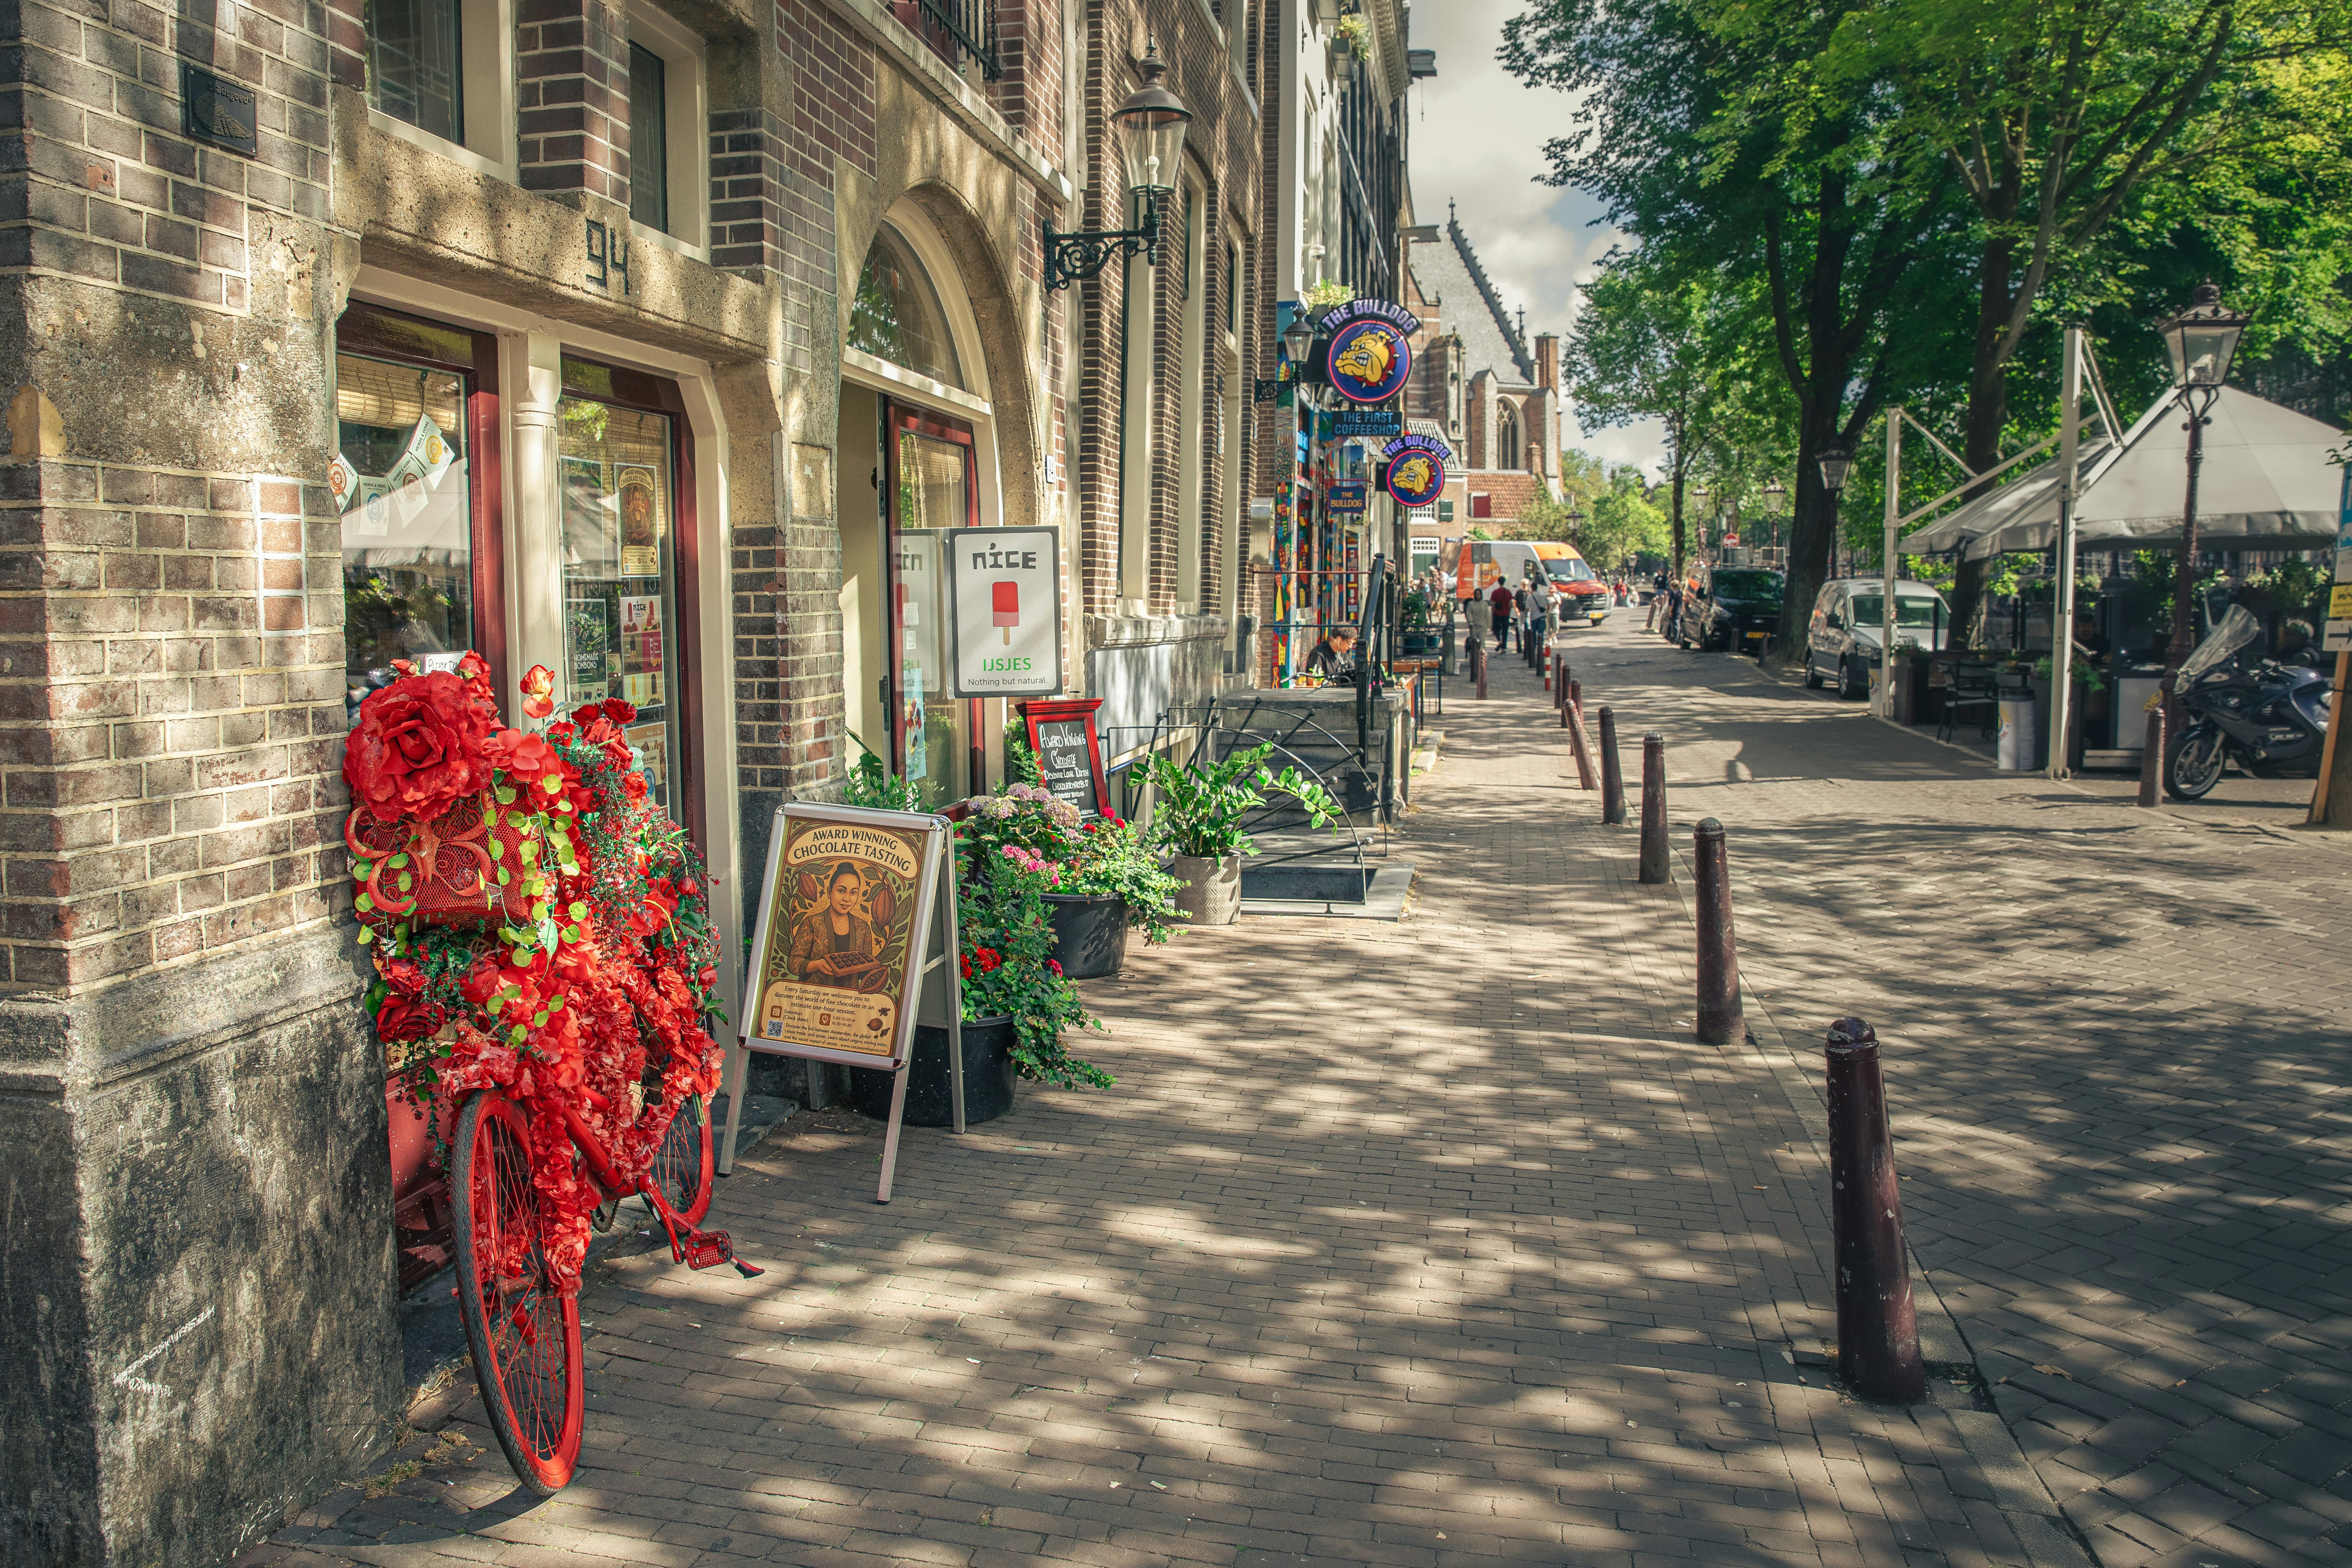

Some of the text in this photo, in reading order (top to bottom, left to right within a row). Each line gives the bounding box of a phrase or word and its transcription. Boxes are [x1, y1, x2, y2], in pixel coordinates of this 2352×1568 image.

[208, 81, 249, 105] Stadsgoed
[585, 219, 629, 295] 94
[1322, 299, 1418, 332] THE BULLDOG
[1342, 412, 1393, 423] THE FIRST
[1335, 424, 1400, 435] COFFEESHOP
[1383, 435, 1449, 459] THE BULLDOG
[345, 465, 354, 478] VERRE
[393, 471, 402, 482] HEINDE
[634, 470, 647, 478] WINNING
[621, 476, 652, 488] CHOCOLATE TASTING
[1331, 499, 1363, 507] BULLDOG
[574, 653, 598, 662] HOMEMADE
[574, 661, 597, 670] BONBONS
[983, 657, 1032, 671] IJSJES
[812, 829, 898, 850] AWARD WINNING
[794, 842, 911, 871] CHOCOLATE TASTING
[841, 1044, 887, 1053] www.cacaoandspice.com
